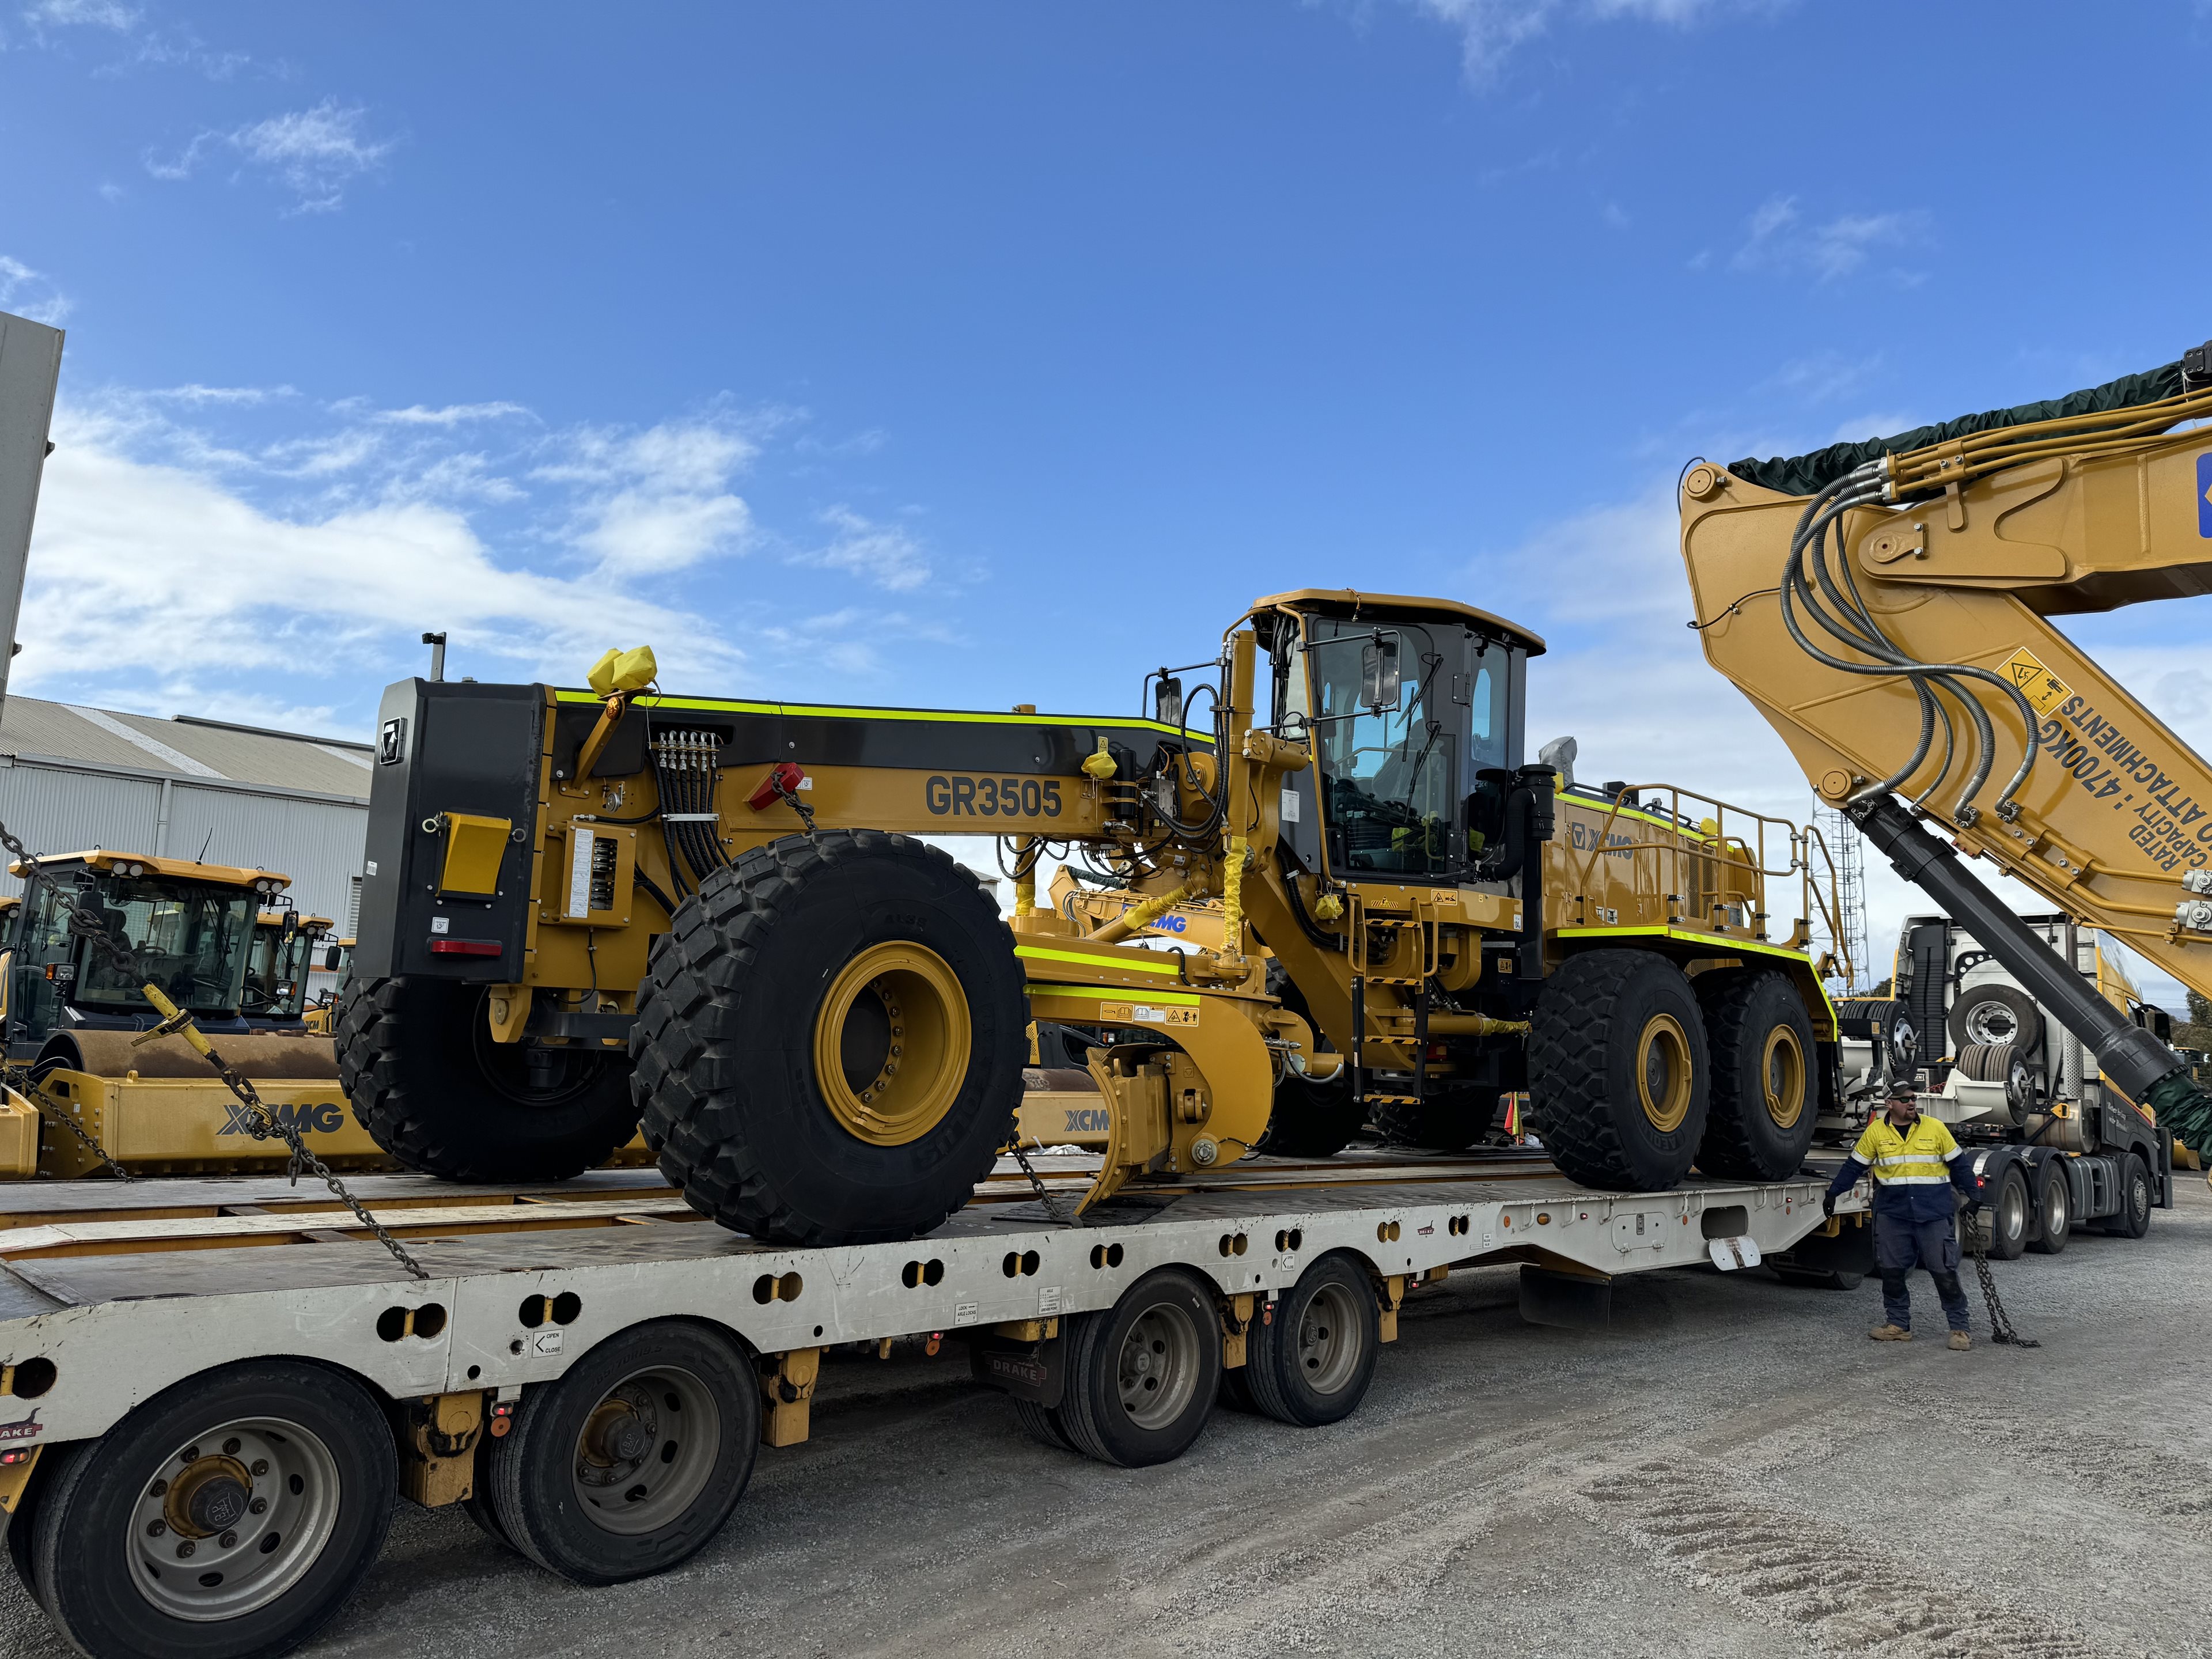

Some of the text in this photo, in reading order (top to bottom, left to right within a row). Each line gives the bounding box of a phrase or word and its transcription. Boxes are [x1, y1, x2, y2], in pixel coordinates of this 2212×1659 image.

[2038, 720, 2122, 798] 4700KG
[2061, 696, 2208, 825] ATTACHMENTS
[926, 776, 1062, 817] GR3505
[2128, 824, 2181, 872] RATED
[2133, 802, 2207, 867] CAPACITY
[1149, 914, 1186, 933] MG
[1064, 1109, 1109, 1131] XCM
[993, 1359, 1037, 1381] DRAKE
[0, 1427, 33, 1438] AKE
